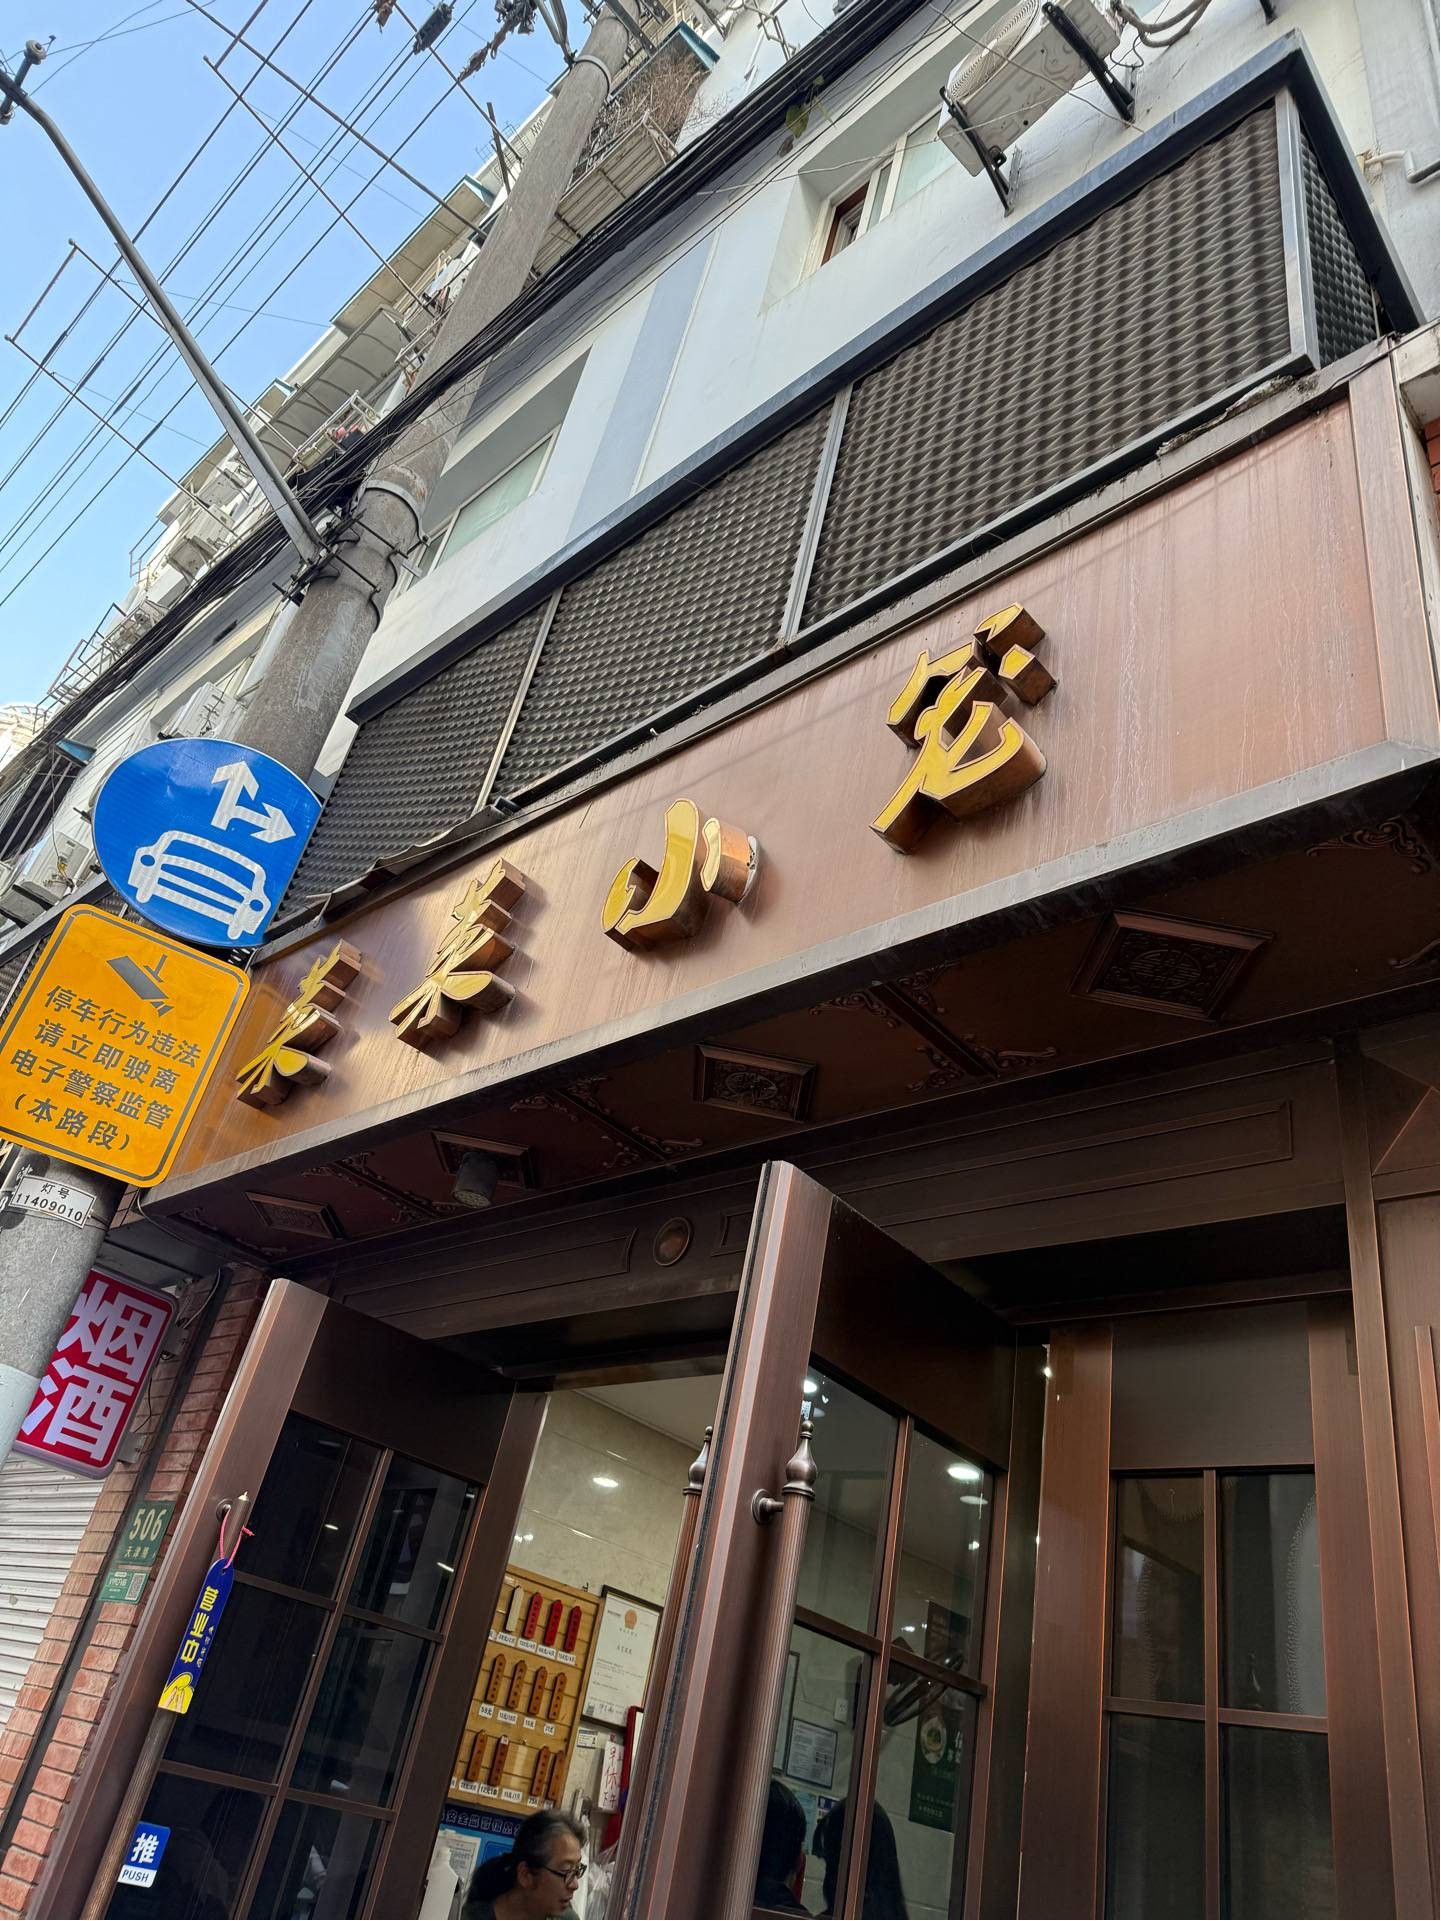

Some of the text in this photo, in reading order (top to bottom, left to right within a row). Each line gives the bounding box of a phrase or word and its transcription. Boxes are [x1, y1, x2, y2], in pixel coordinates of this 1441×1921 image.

[43, 985, 202, 1068] 停车行为违法
[34, 1019, 181, 1094] 请立即驶离
[10, 1048, 175, 1130] 电子警察监管
[16, 1193, 83, 1221] 11409010
[40, 1182, 70, 1199] 灯号
[21, 1280, 168, 1461] 烟酒
[129, 1508, 167, 1541] 506
[180, 1586, 219, 1664] 营业中
[130, 1832, 160, 1864] 推
[122, 1868, 150, 1883] PUSH
